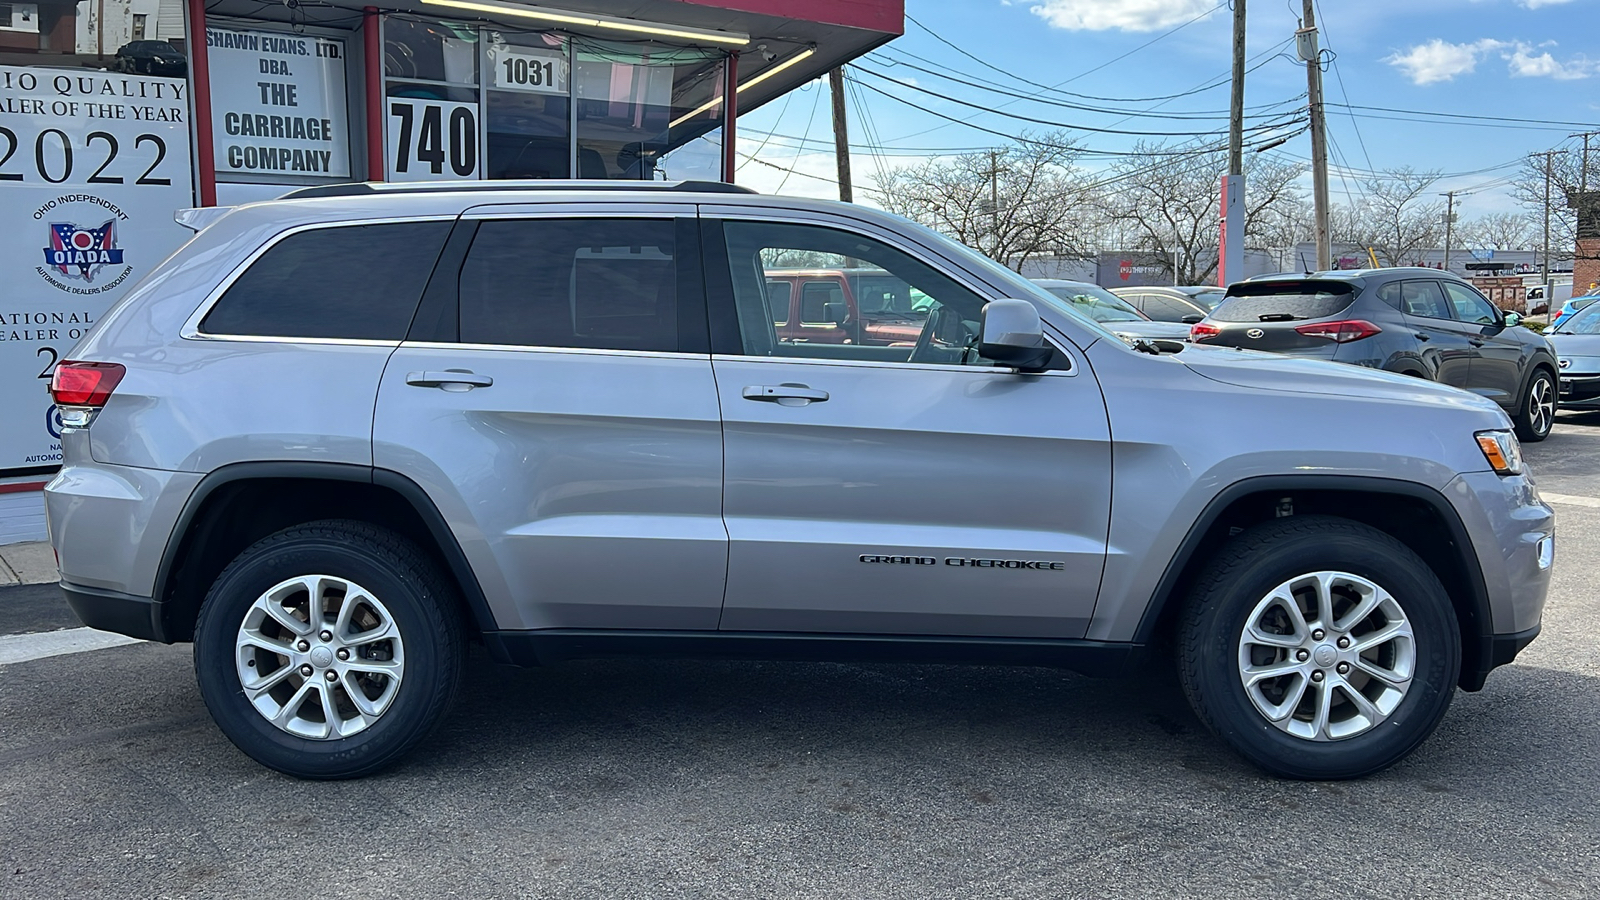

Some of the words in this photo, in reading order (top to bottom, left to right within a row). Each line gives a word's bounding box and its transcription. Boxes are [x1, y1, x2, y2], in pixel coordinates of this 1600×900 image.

[205, 30, 258, 51] SHAWN
[315, 42, 342, 59] LTD.
[259, 58, 293, 76] DBA.
[502, 57, 553, 87] 1031
[53, 75, 184, 100] QUALITY
[257, 81, 298, 107] THE
[51, 101, 79, 118] OF
[84, 102, 126, 120] THE
[131, 105, 184, 123] YEAR
[224, 112, 332, 141] CARRIAGE
[390, 102, 476, 177] 740
[0, 126, 172, 186] 2022
[228, 145, 332, 173] COMPANY
[33, 200, 57, 221] OHIO
[57, 194, 130, 221] INDEPENDENT
[54, 250, 111, 264] OIADA
[35, 265, 71, 293] AUTOMOBILE
[71, 287, 101, 295] DEALERS
[101, 265, 133, 293] ASSOCIATION
[859, 553, 936, 566] GRAND
[944, 556, 1065, 571] CHEROKEE
